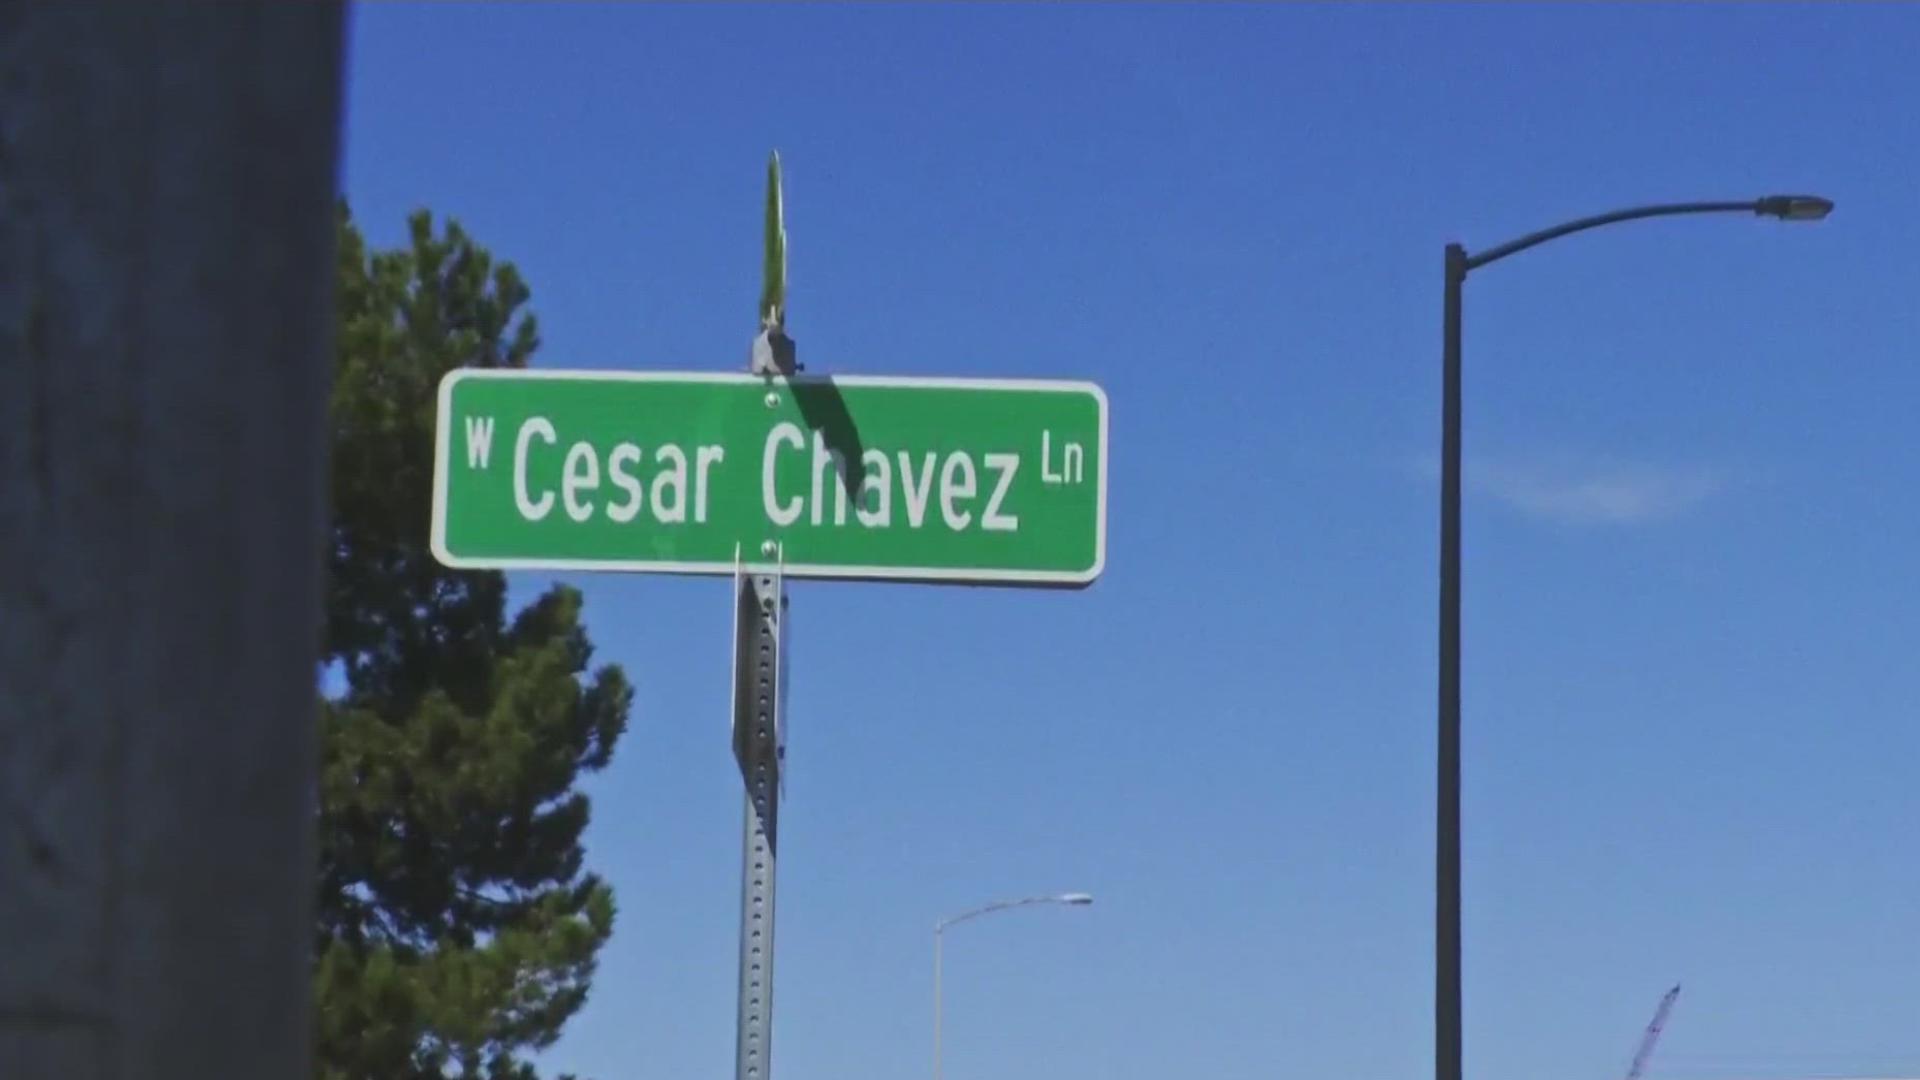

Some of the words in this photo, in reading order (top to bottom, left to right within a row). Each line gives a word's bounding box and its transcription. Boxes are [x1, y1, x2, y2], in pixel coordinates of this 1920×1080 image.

[465, 416, 494, 468] W
[513, 416, 724, 522] Cesar
[762, 422, 1020, 531] Chavez
[1041, 430, 1083, 483] Ln
